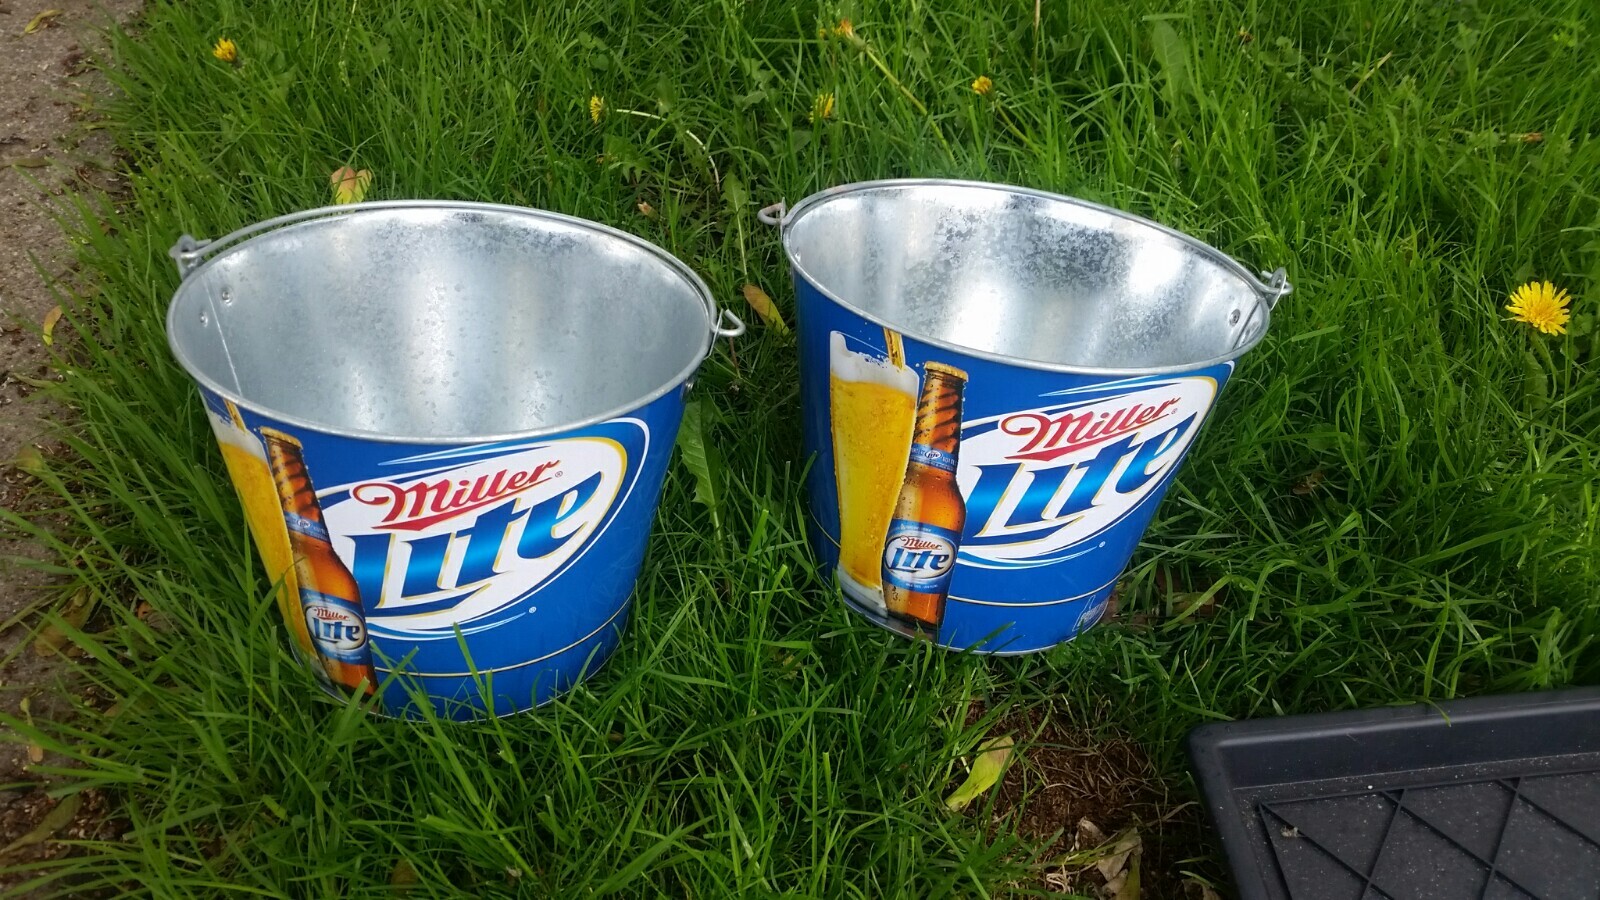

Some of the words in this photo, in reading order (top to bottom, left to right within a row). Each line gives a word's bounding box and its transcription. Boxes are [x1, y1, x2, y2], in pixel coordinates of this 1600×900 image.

[1001, 397, 1181, 458] Miller
[352, 459, 560, 528] Miller
[961, 411, 1198, 545] Lite
[341, 470, 603, 617] Lite
[889, 547, 950, 573] Lite
[900, 535, 943, 550] Miller
[312, 606, 350, 621] Miller
[312, 617, 360, 643] Lite
